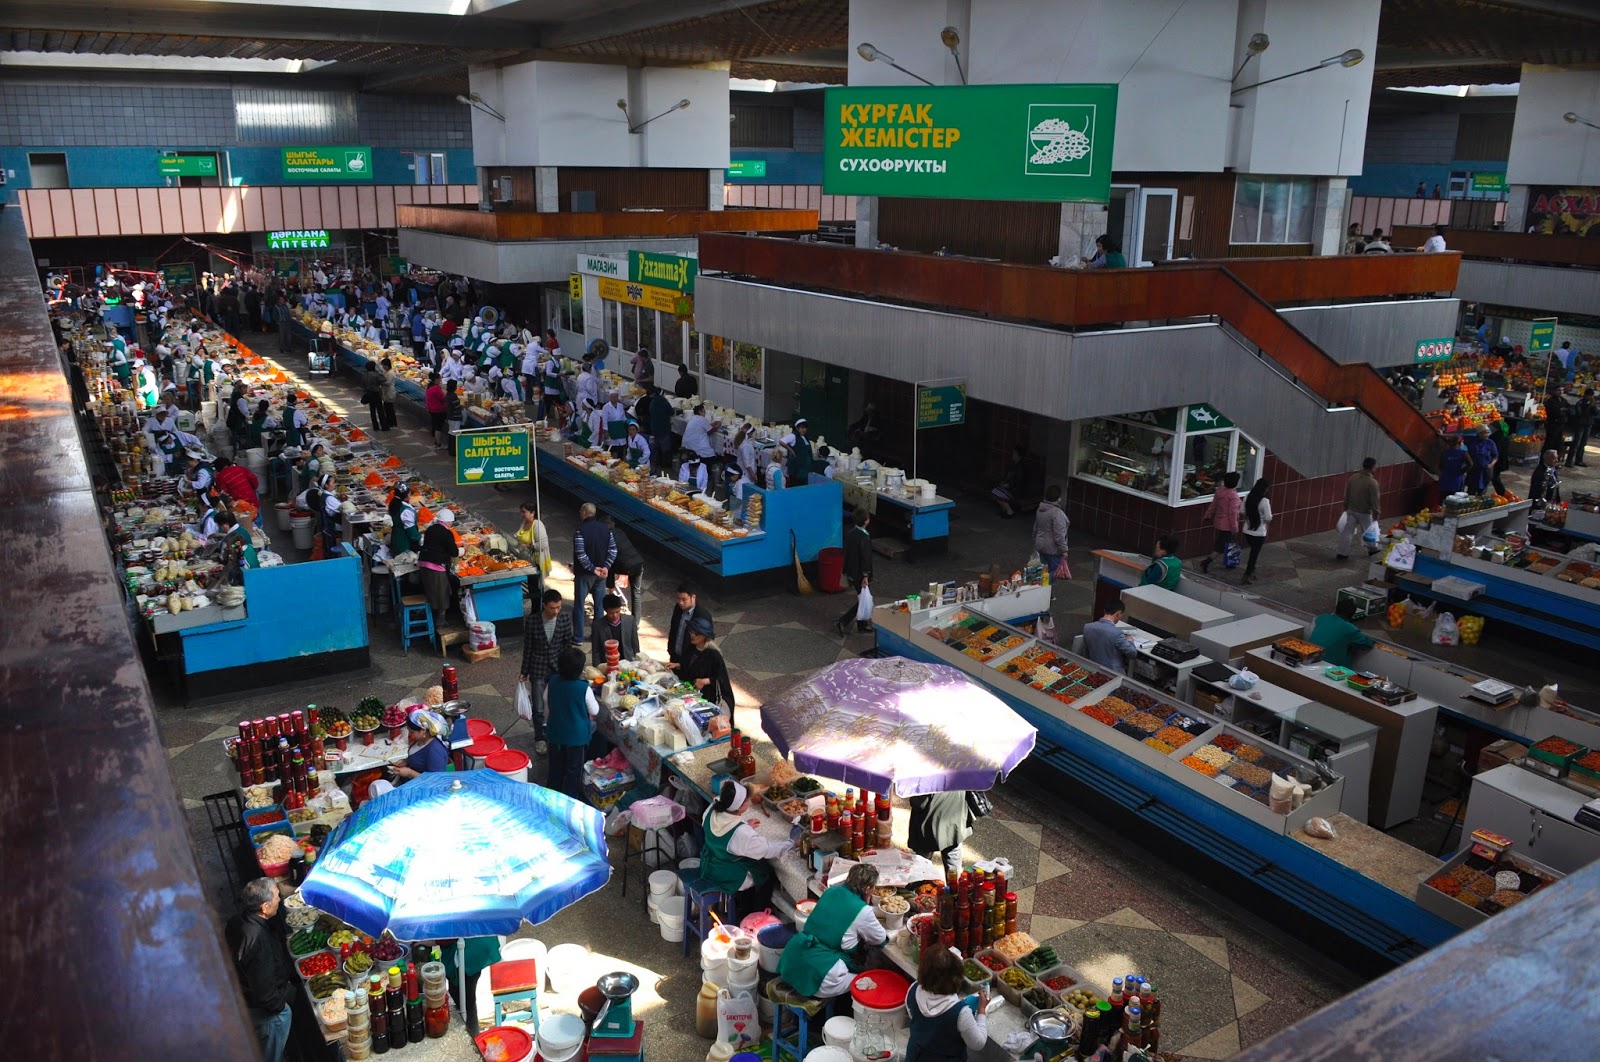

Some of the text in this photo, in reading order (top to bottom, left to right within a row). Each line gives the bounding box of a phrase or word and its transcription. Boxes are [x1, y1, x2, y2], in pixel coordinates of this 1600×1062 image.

[840, 104, 933, 127] ҚҰРҒАҚ
[840, 127, 961, 148] ЖЕМІСТЕР
[286, 158, 335, 166] САЛАТТАРЫ
[840, 158, 947, 173] СУХОФРУКТЫ
[271, 239, 328, 249] АПТЕКА
[587, 258, 618, 275] МАГАЗИН
[472, 435, 512, 447] ШЫҒЫС
[464, 446, 522, 458] САЛАТТАРЫ
